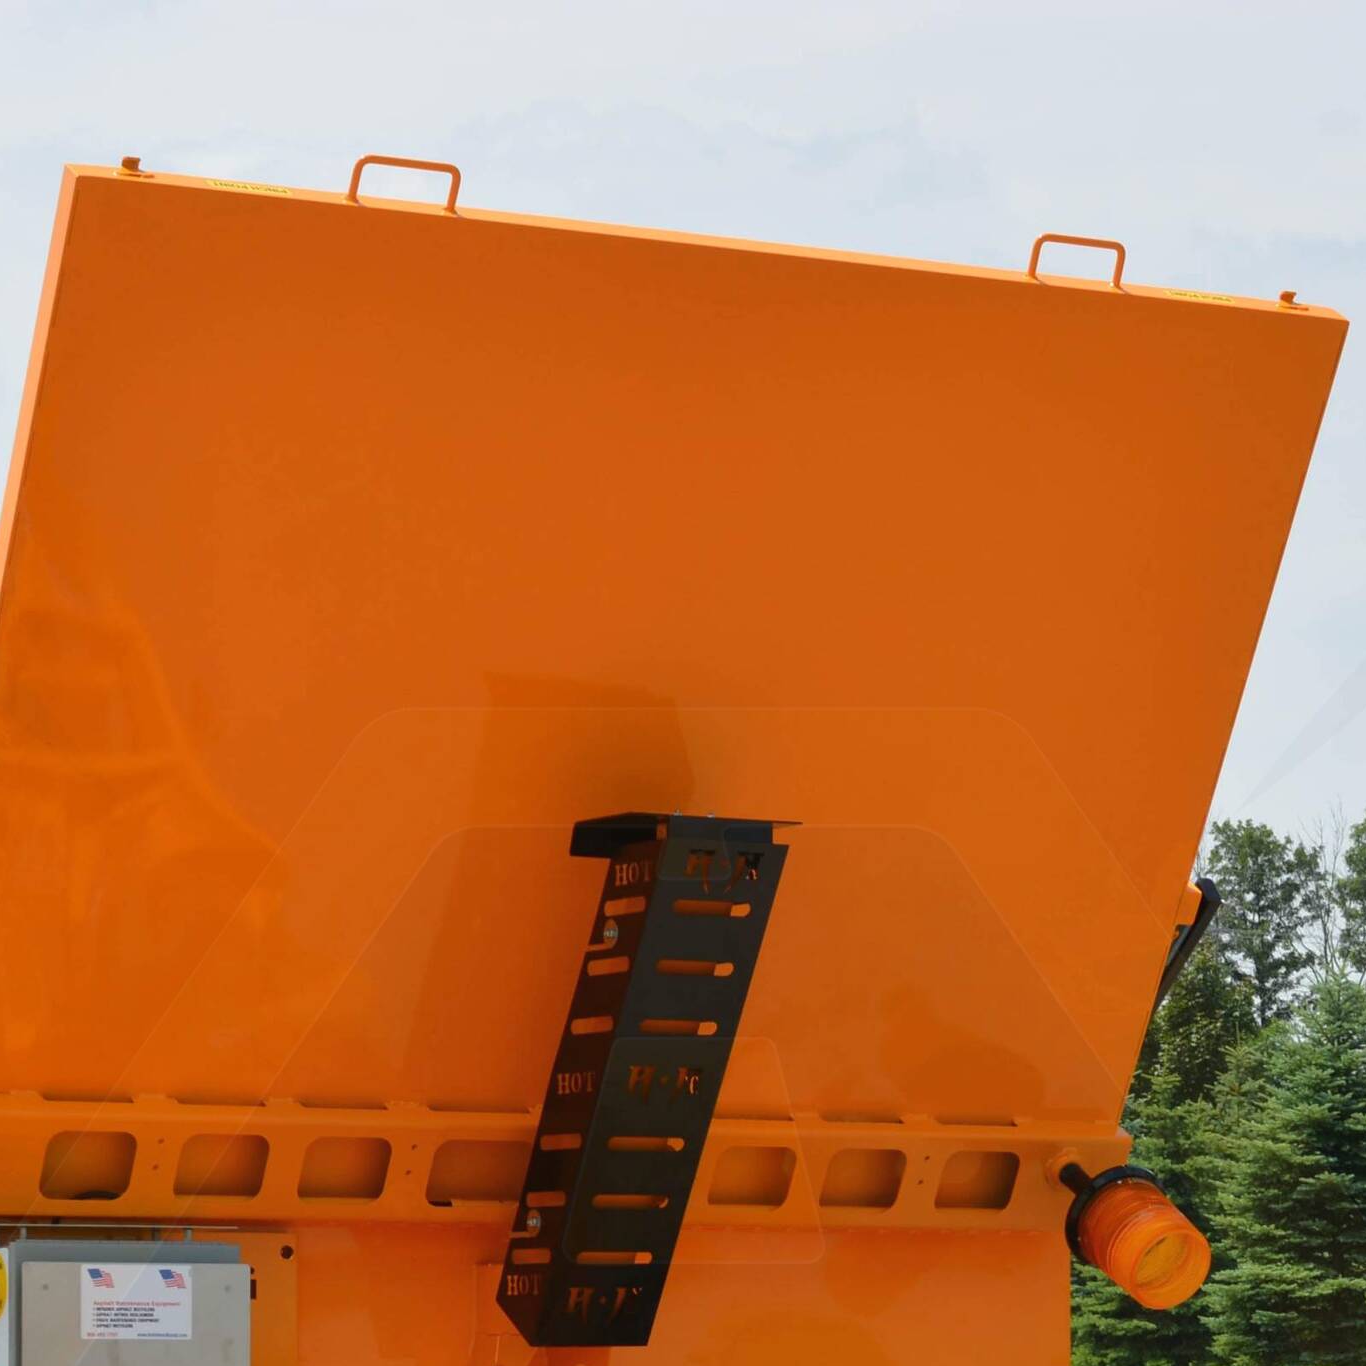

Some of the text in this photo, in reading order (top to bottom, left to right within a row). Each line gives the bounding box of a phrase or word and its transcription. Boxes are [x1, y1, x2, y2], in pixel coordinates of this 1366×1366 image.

[614, 860, 652, 887] HOT
[556, 1071, 595, 1096] HOT
[507, 1273, 541, 1297] HOT
